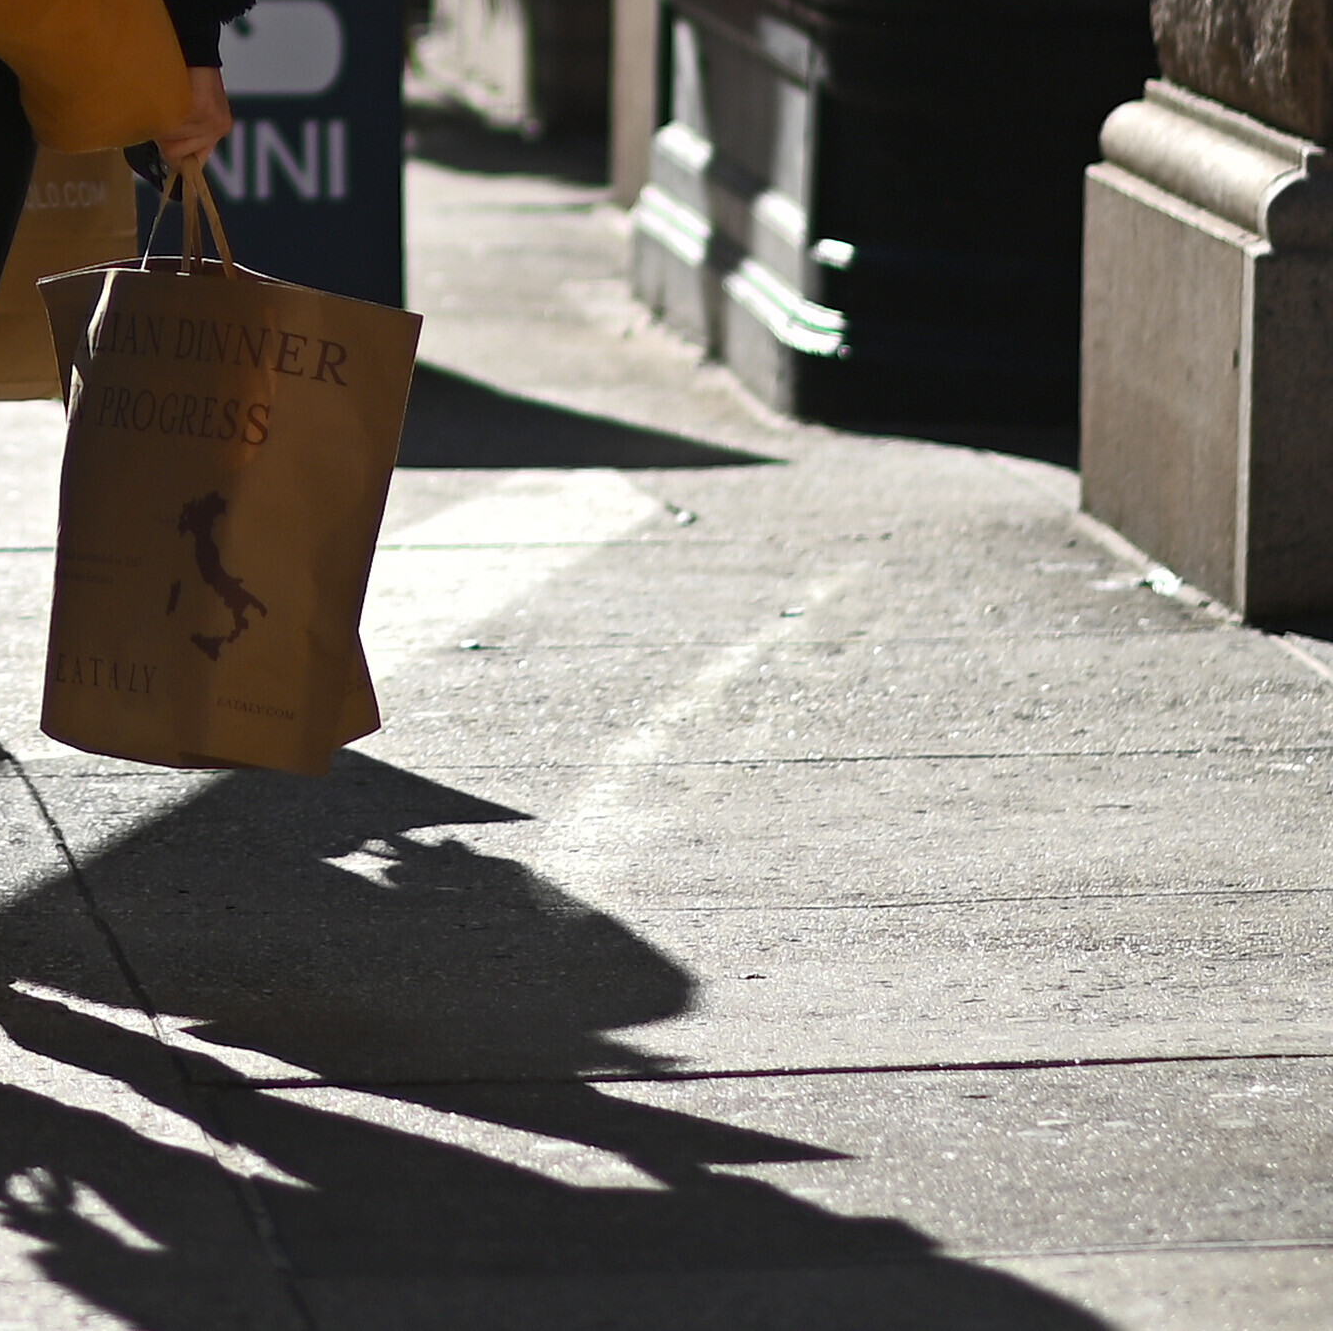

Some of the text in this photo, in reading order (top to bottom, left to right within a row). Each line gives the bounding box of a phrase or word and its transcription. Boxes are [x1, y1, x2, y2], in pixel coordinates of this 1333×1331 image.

[206, 118, 349, 203] NNI
[175, 318, 349, 387] DINNER
[97, 385, 271, 446] PROGRESS
[55, 653, 158, 695] EATALY
[216, 695, 296, 721] EATALY.COM
